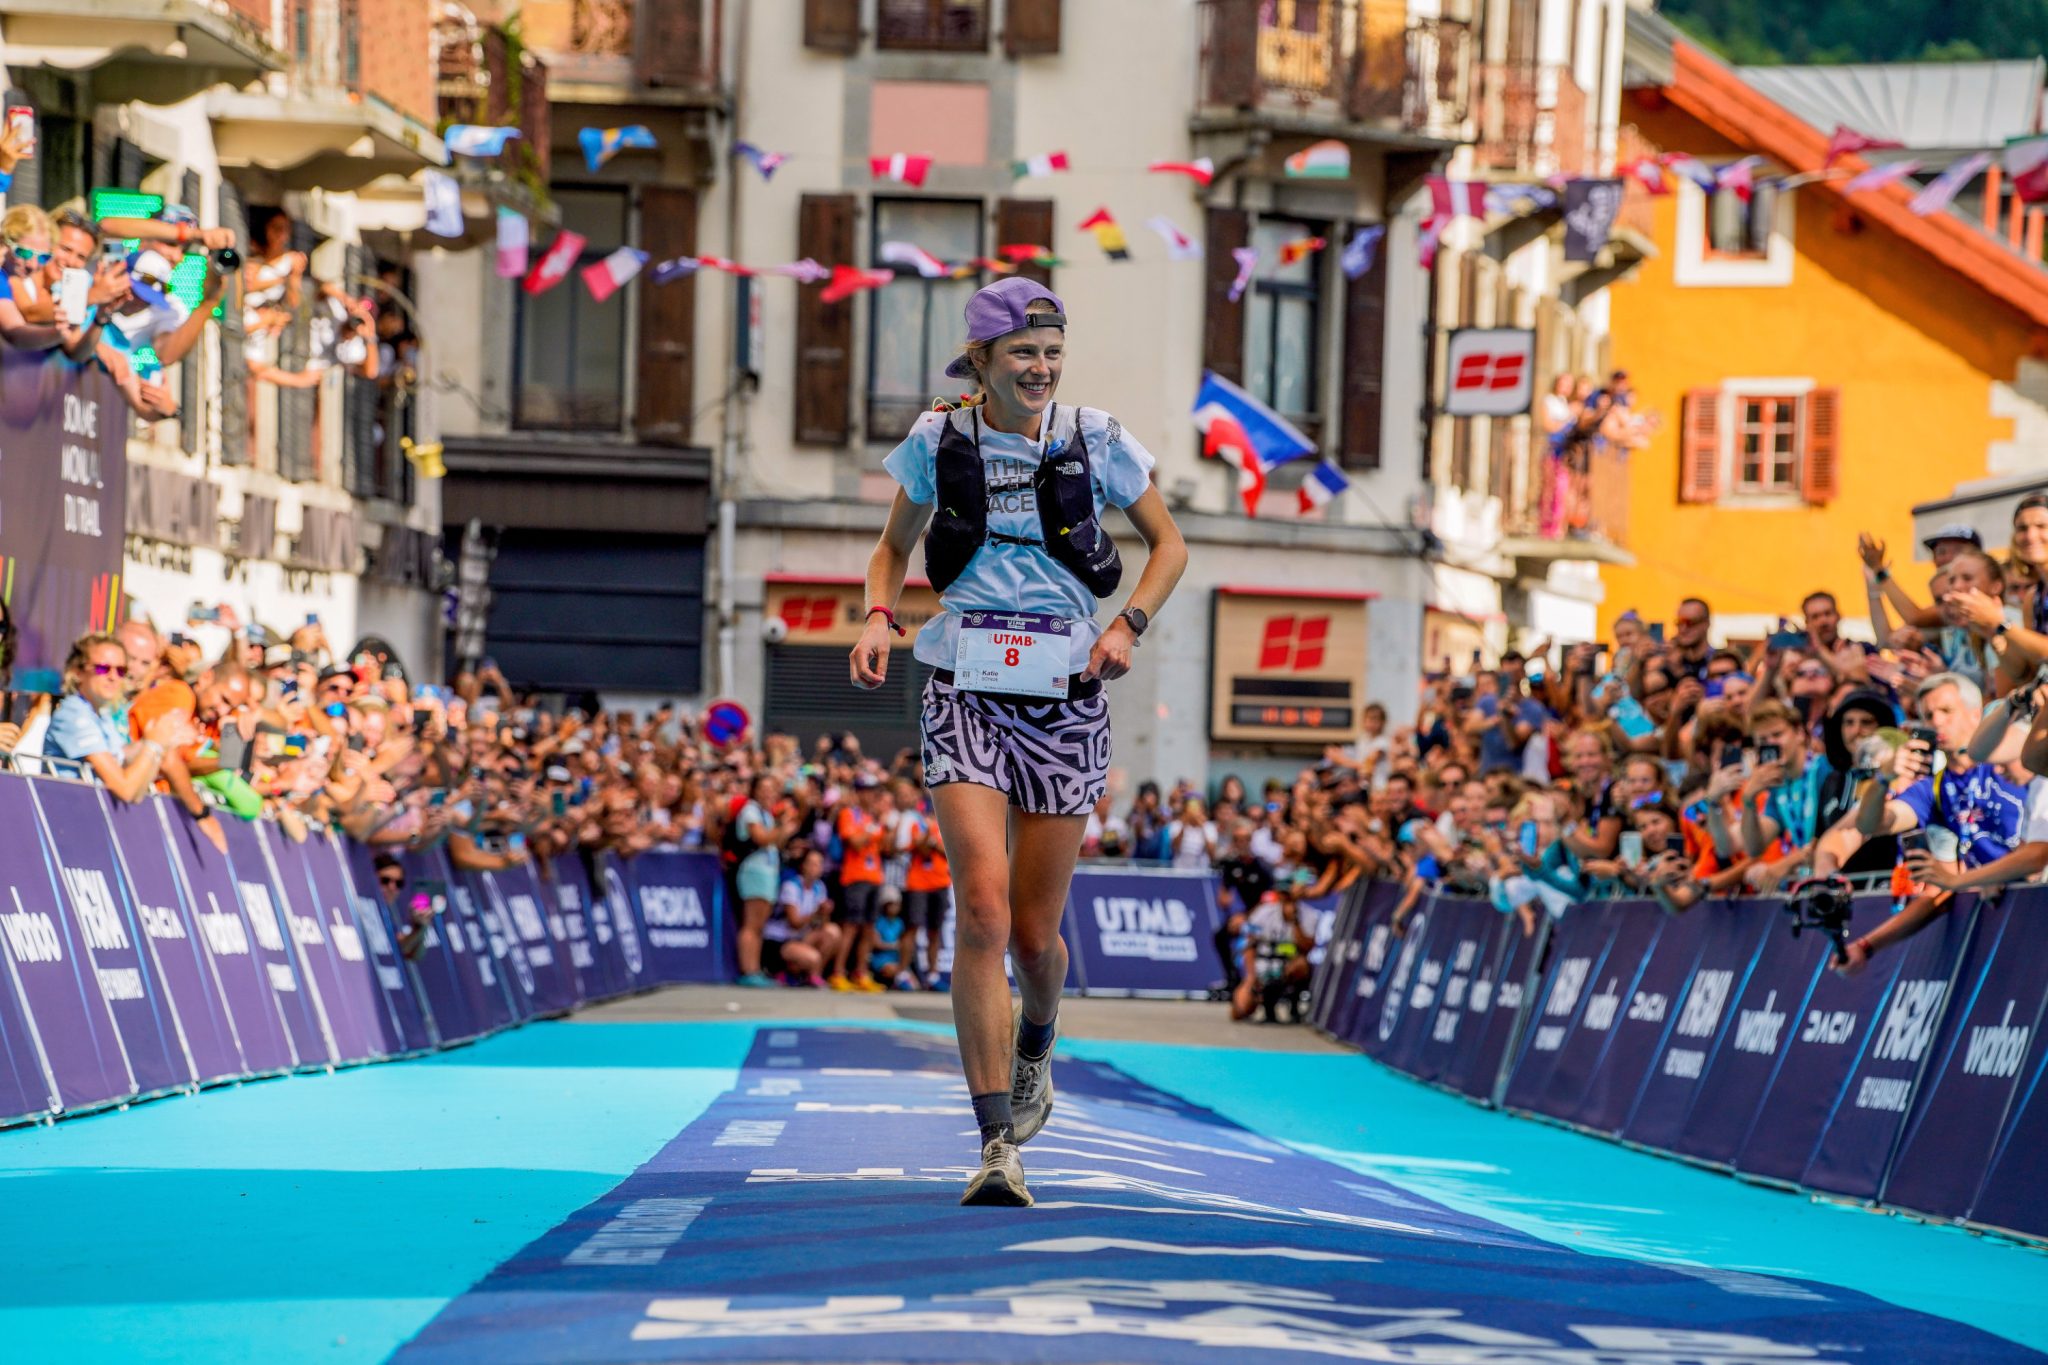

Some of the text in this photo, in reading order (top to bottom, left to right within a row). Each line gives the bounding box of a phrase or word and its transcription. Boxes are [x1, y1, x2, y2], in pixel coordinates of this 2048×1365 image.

[986, 459, 1034, 477] THE
[988, 493, 1035, 514] ACE
[994, 633, 1033, 646] UTMB
[1004, 648, 1020, 667] 8
[981, 669, 999, 677] Katie
[1093, 896, 1193, 935] UTMB
[1963, 999, 2030, 1077] wahoo
